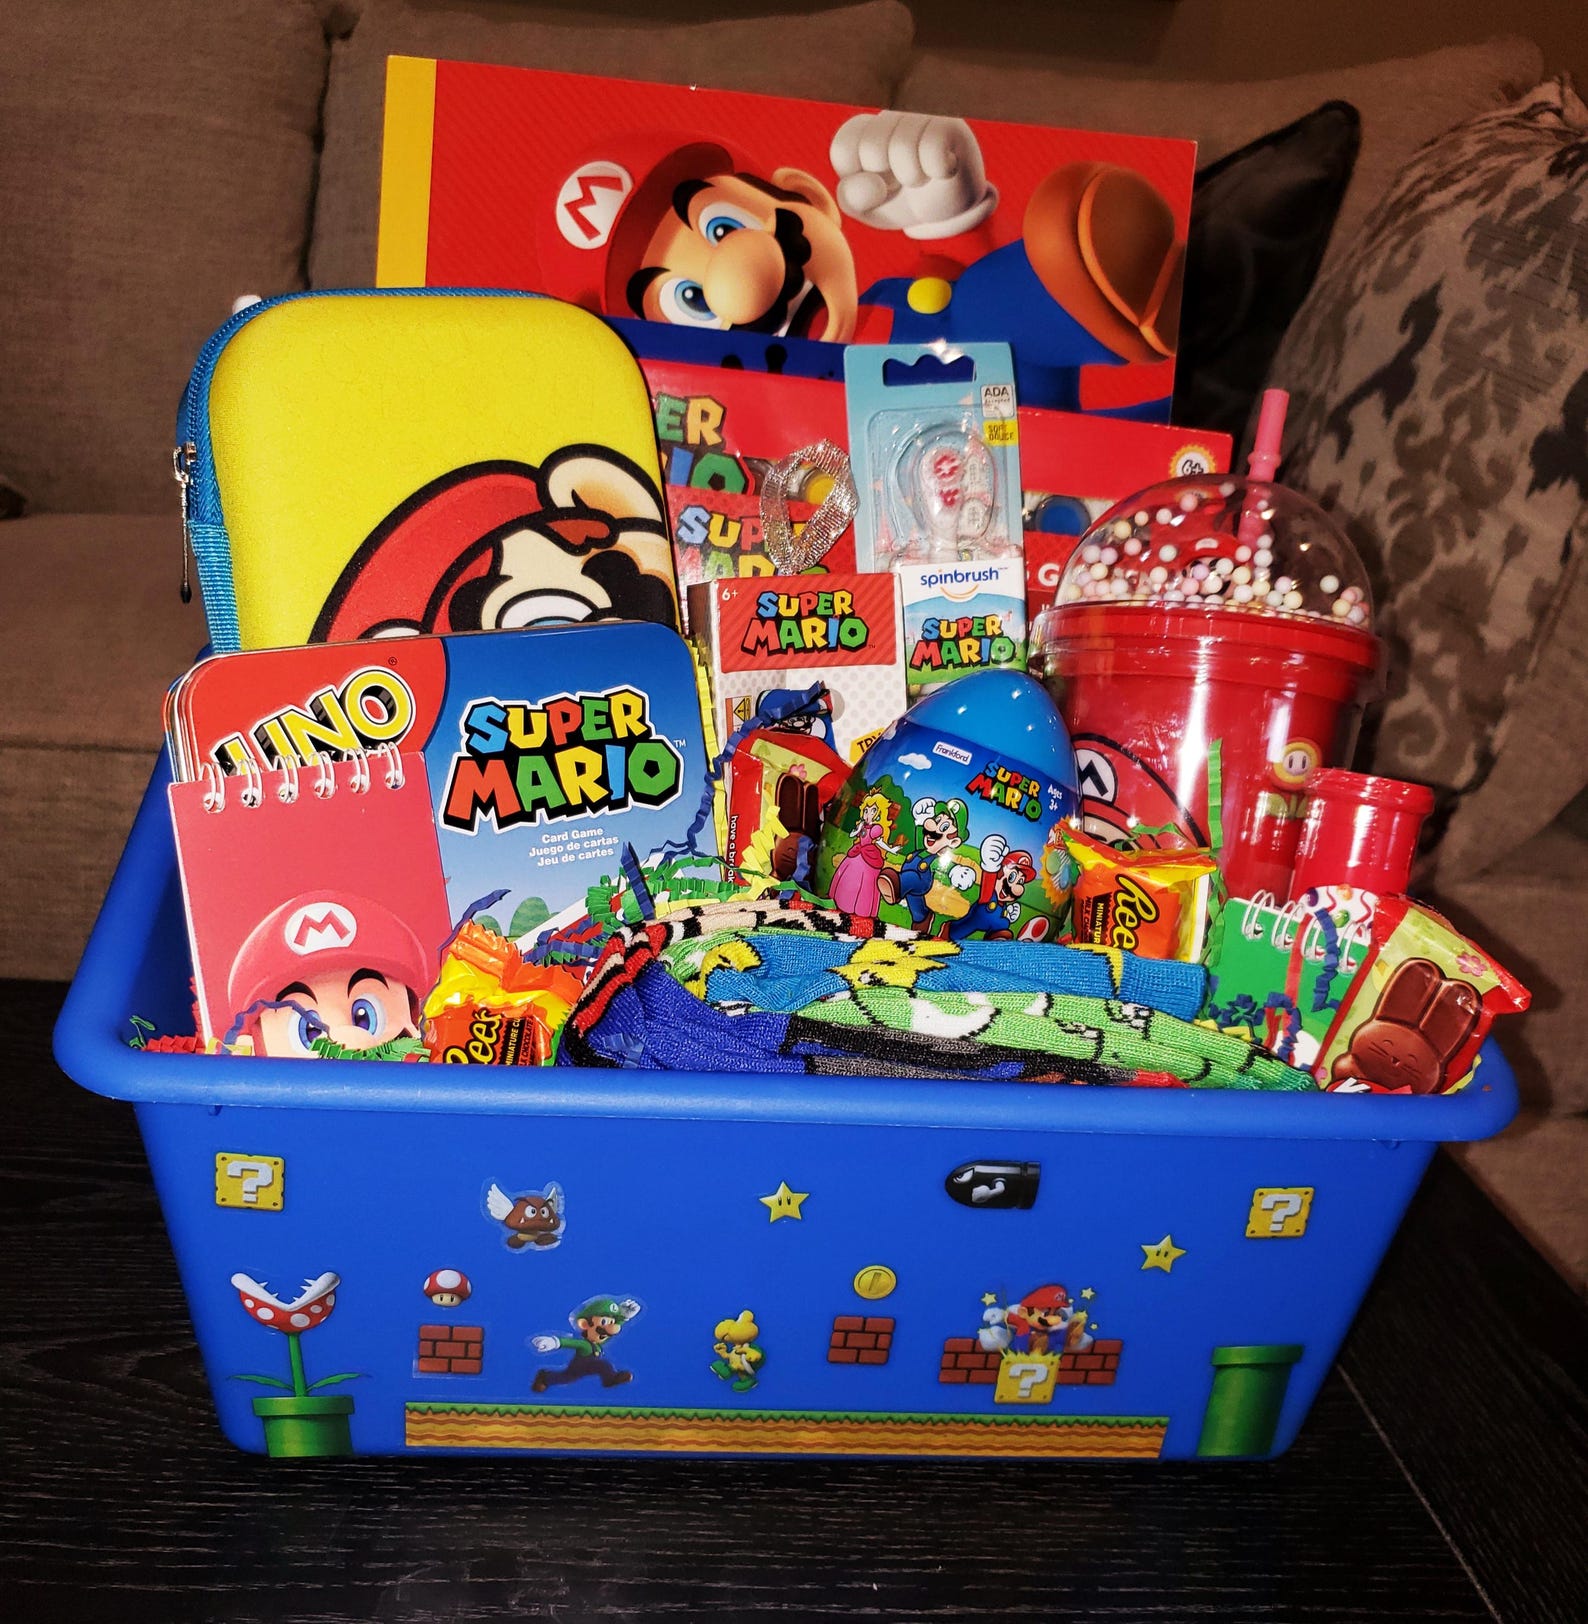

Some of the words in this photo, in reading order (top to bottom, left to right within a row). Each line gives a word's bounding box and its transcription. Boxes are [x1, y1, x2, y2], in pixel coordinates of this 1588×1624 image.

[984, 387, 1009, 397] ADA
[920, 566, 999, 588] spinbrush
[721, 588, 739, 601] 6+
[756, 589, 855, 619] SUPER
[741, 616, 869, 657] MARIO
[921, 613, 1004, 641] SUPER
[909, 636, 1016, 672] MARIO
[464, 688, 652, 756] SUPER
[935, 744, 970, 763] Frankford
[442, 740, 681, 830] MARIO
[984, 761, 1041, 798] SUPER
[1047, 784, 1063, 800] Ages
[965, 773, 1043, 822] MARIO
[541, 832, 569, 844] Card
[571, 828, 604, 839] Game
[729, 815, 739, 840] have
[529, 844, 564, 857] Juego
[566, 841, 581, 851] de
[583, 836, 619, 848] cartas
[537, 856, 559, 867] Jeu
[561, 853, 576, 862] de
[578, 847, 615, 860] cartes
[729, 842, 736, 850] a
[1093, 902, 1105, 943] MINIATUR
